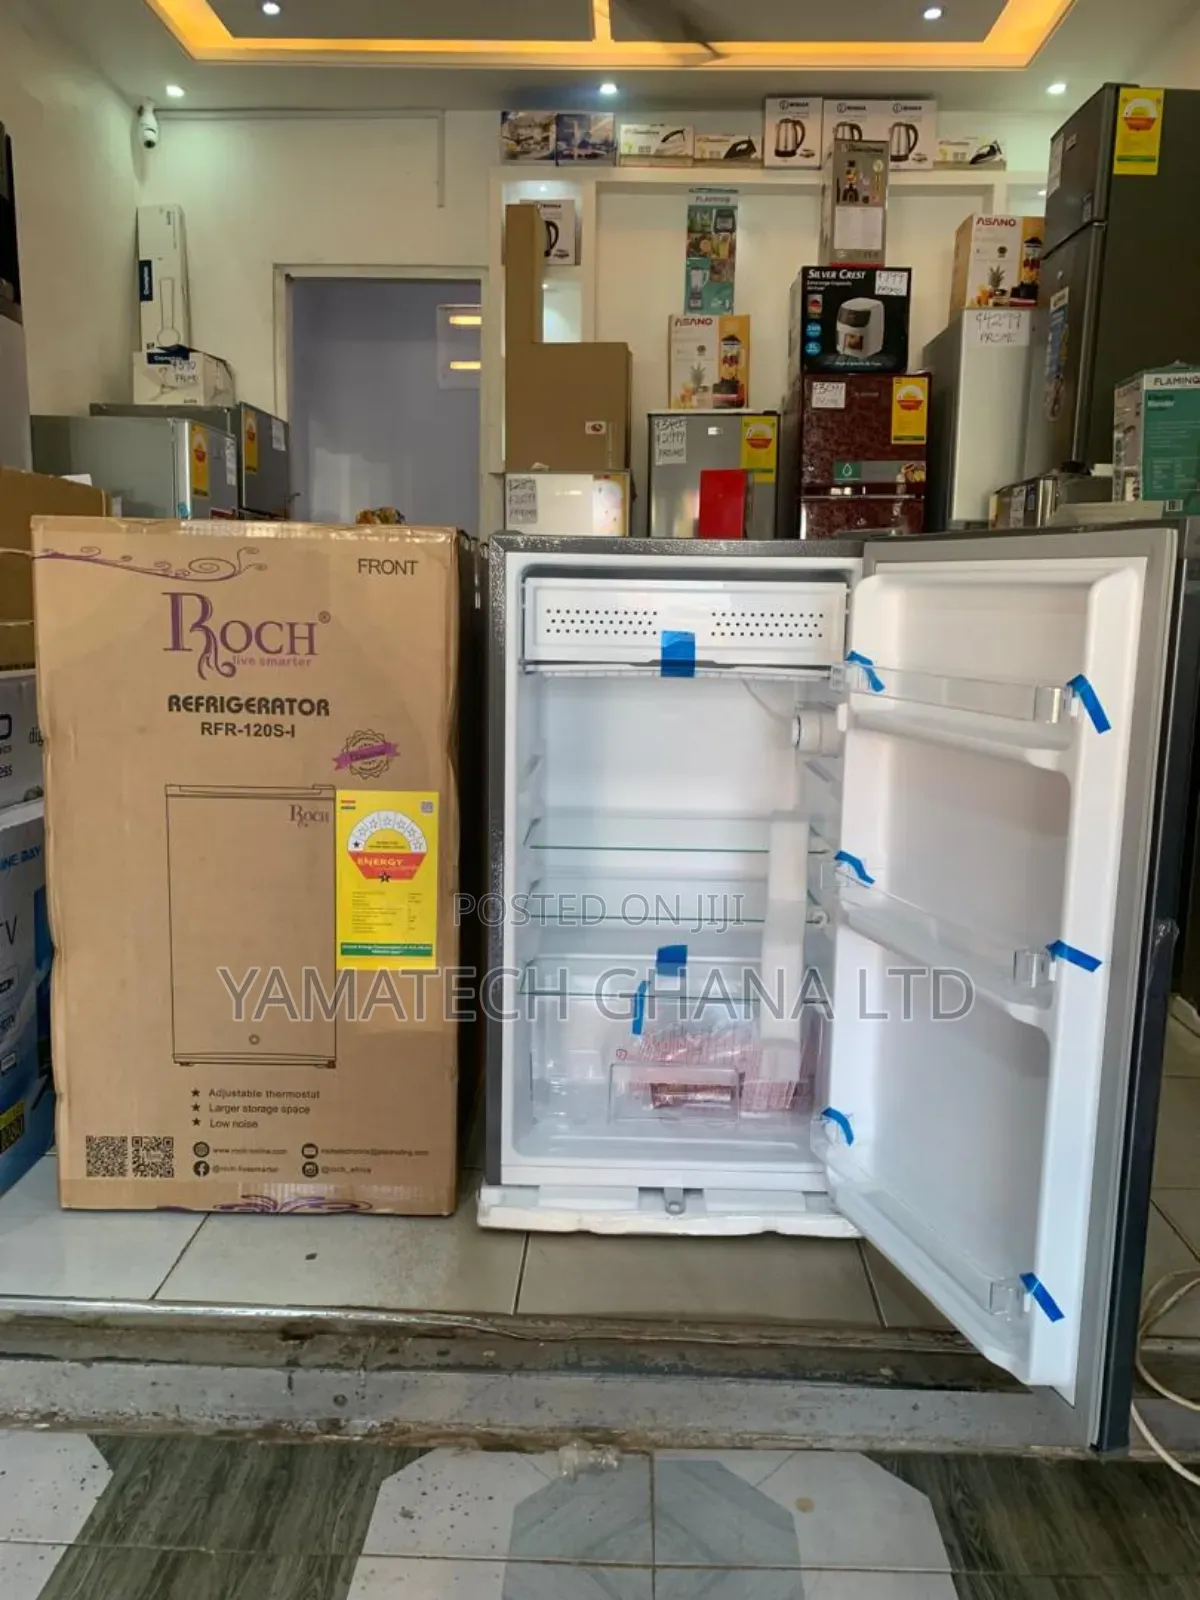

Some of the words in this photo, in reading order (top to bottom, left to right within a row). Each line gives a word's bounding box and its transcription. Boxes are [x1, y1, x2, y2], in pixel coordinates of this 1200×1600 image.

[976, 217, 1016, 227] ASANO
[839, 269, 867, 280] CREST
[674, 317, 713, 327] ASANO
[357, 558, 418, 576] FRONT
[259, 656, 312, 668] smarter
[167, 694, 330, 716] REFRIGERATOR
[200, 721, 296, 739] RFR-120S-I
[356, 857, 405, 867] ENERGY
[209, 1088, 263, 1100] Adjustable
[265, 1089, 320, 1100] thermostat
[208, 1104, 240, 1115] Larger
[242, 1104, 278, 1115] storage
[280, 1106, 311, 1115] space
[209, 1119, 231, 1128] Low
[232, 1119, 259, 1128] noise
